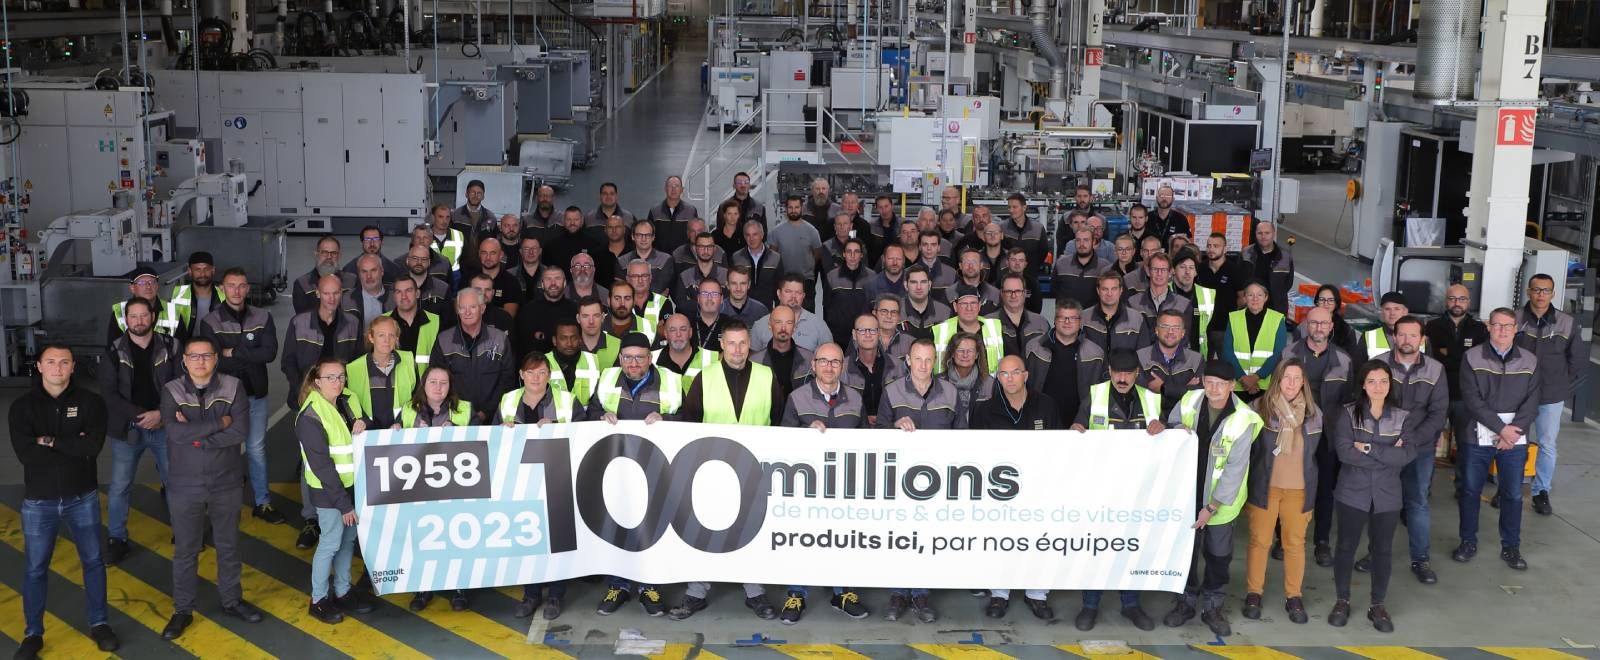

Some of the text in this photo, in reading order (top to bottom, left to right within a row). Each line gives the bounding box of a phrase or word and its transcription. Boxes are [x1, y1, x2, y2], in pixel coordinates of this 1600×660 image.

[373, 452, 482, 492] 1958
[520, 433, 1020, 554] 100 millions
[772, 502, 1182, 523] de moteurs & de boîtes de vitesses
[417, 511, 542, 550] 2023
[771, 529, 1140, 556] produits ici, par nos équipes
[372, 568, 405, 577] Renault
[373, 576, 399, 584] Group
[1159, 569, 1182, 577] CLÉON
